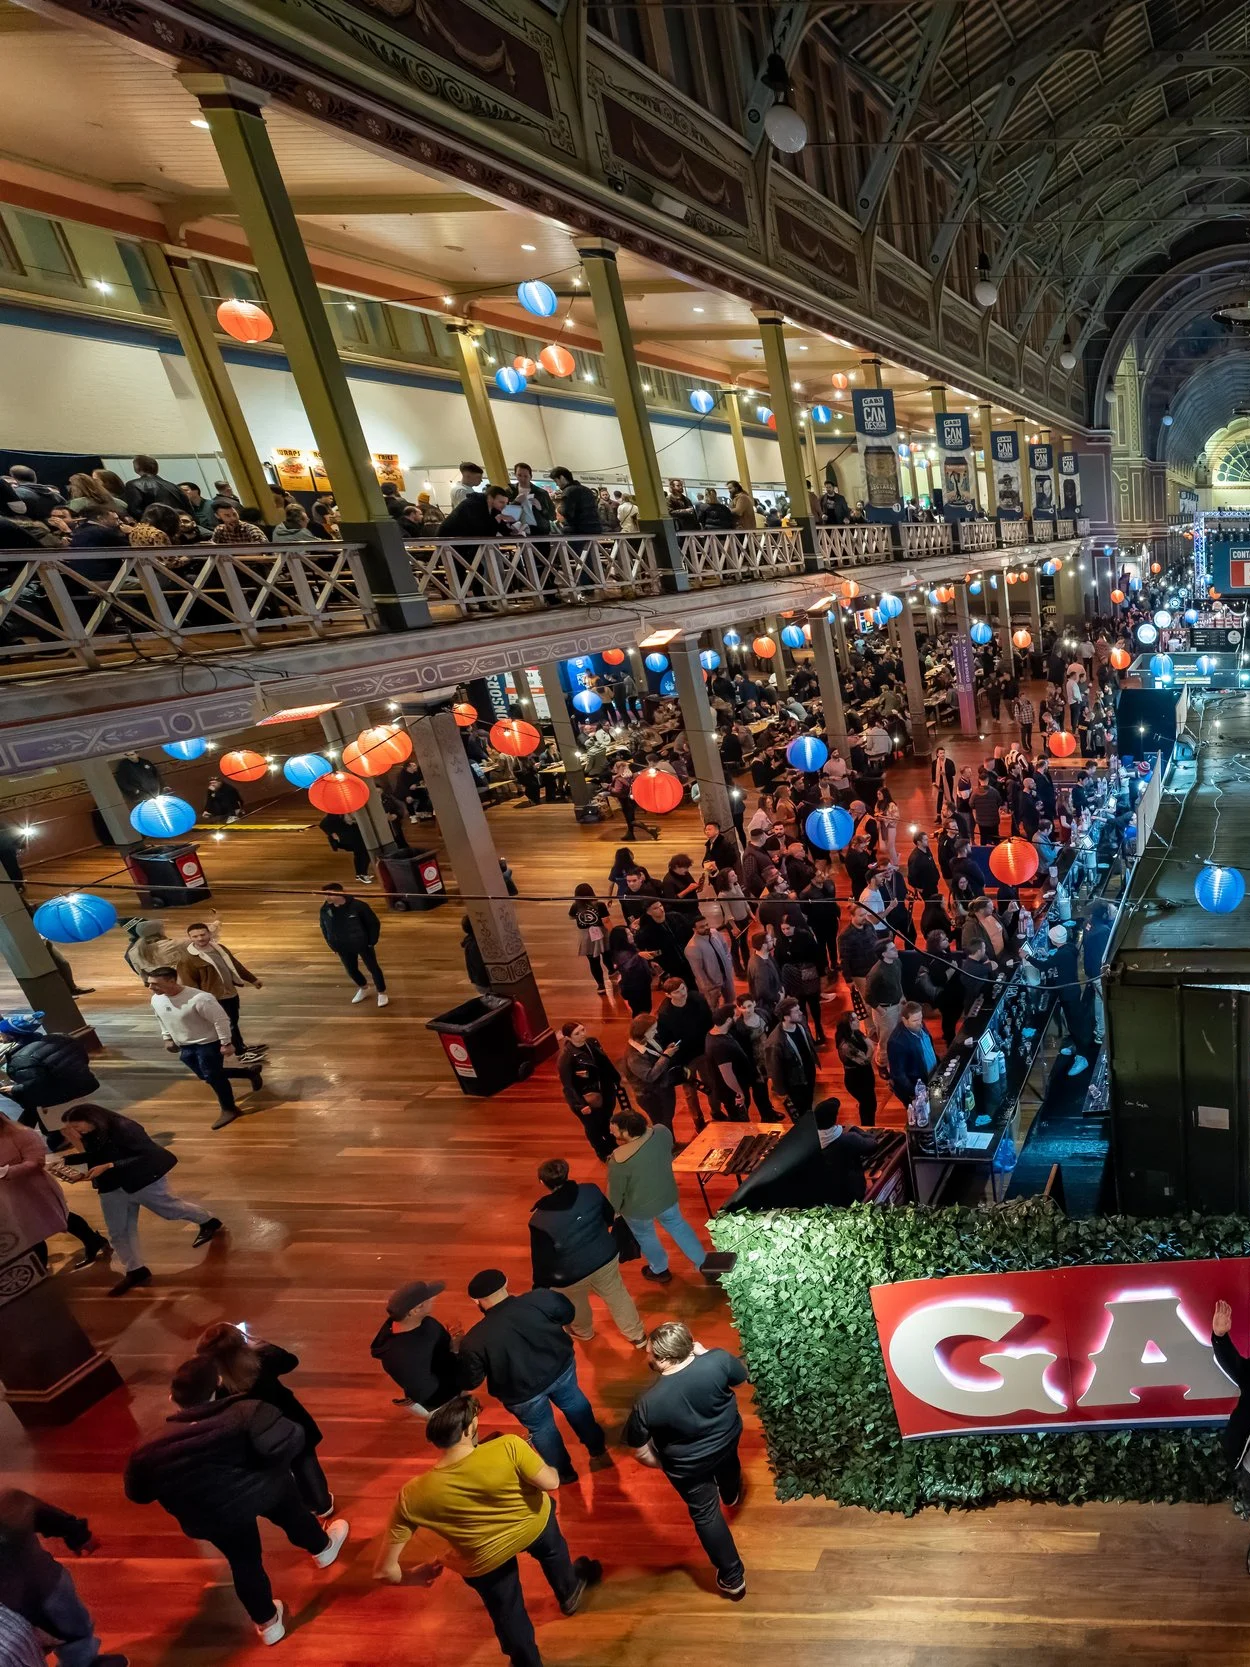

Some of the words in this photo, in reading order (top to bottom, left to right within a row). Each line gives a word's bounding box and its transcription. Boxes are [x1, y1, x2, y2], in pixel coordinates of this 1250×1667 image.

[864, 407, 886, 421] CAN
[865, 421, 887, 430] DESIGN
[944, 427, 962, 439] CAN
[997, 443, 1013, 453] CAN
[1034, 454, 1048, 462] CAN
[1062, 461, 1075, 469] CAN
[485, 675, 509, 720] ONSORS
